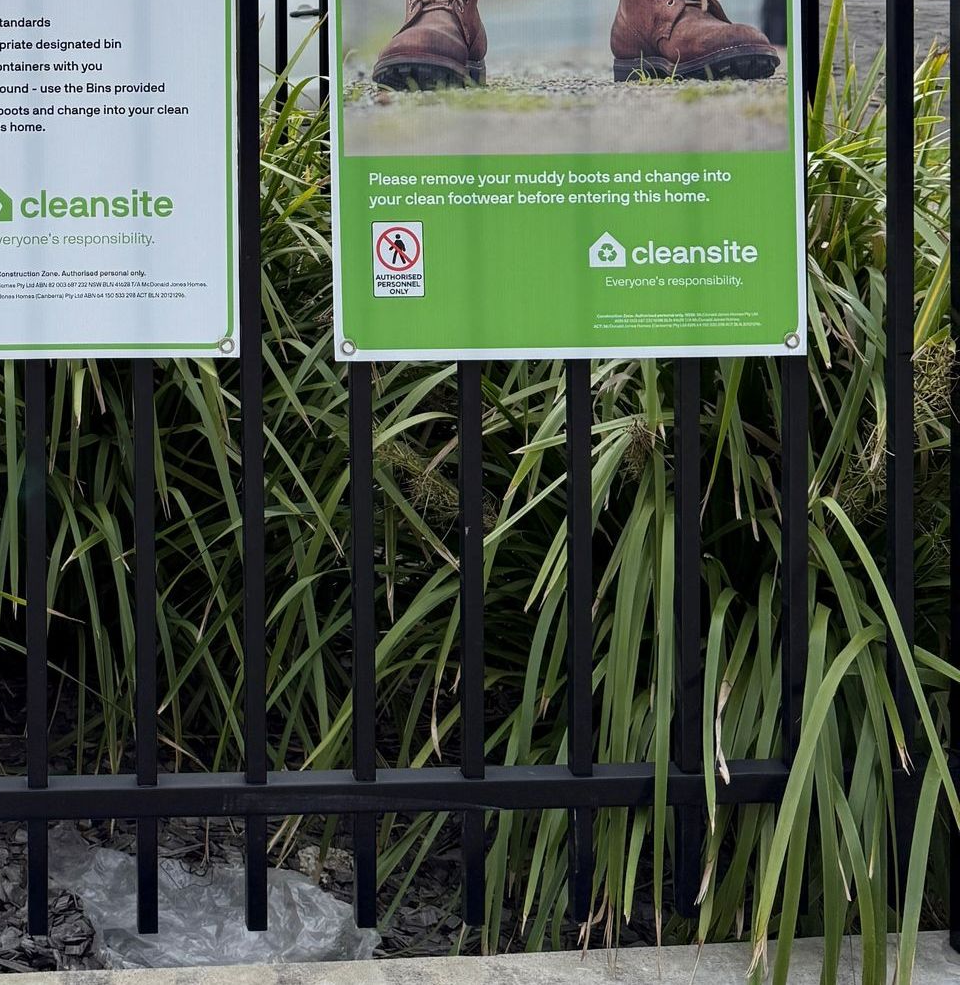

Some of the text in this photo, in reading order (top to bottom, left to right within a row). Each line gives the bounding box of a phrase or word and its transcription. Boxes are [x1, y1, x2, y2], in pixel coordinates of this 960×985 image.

[369, 168, 731, 187] Please remove your muddy boots and change into
[20, 188, 173, 218] cleansite
[368, 189, 709, 208] your clean footwear before entering this home.
[62, 232, 154, 247] responsibility.
[631, 239, 757, 264] cleansite
[130, 269, 146, 277] only.
[605, 274, 743, 288] Everyone's responsibility.
